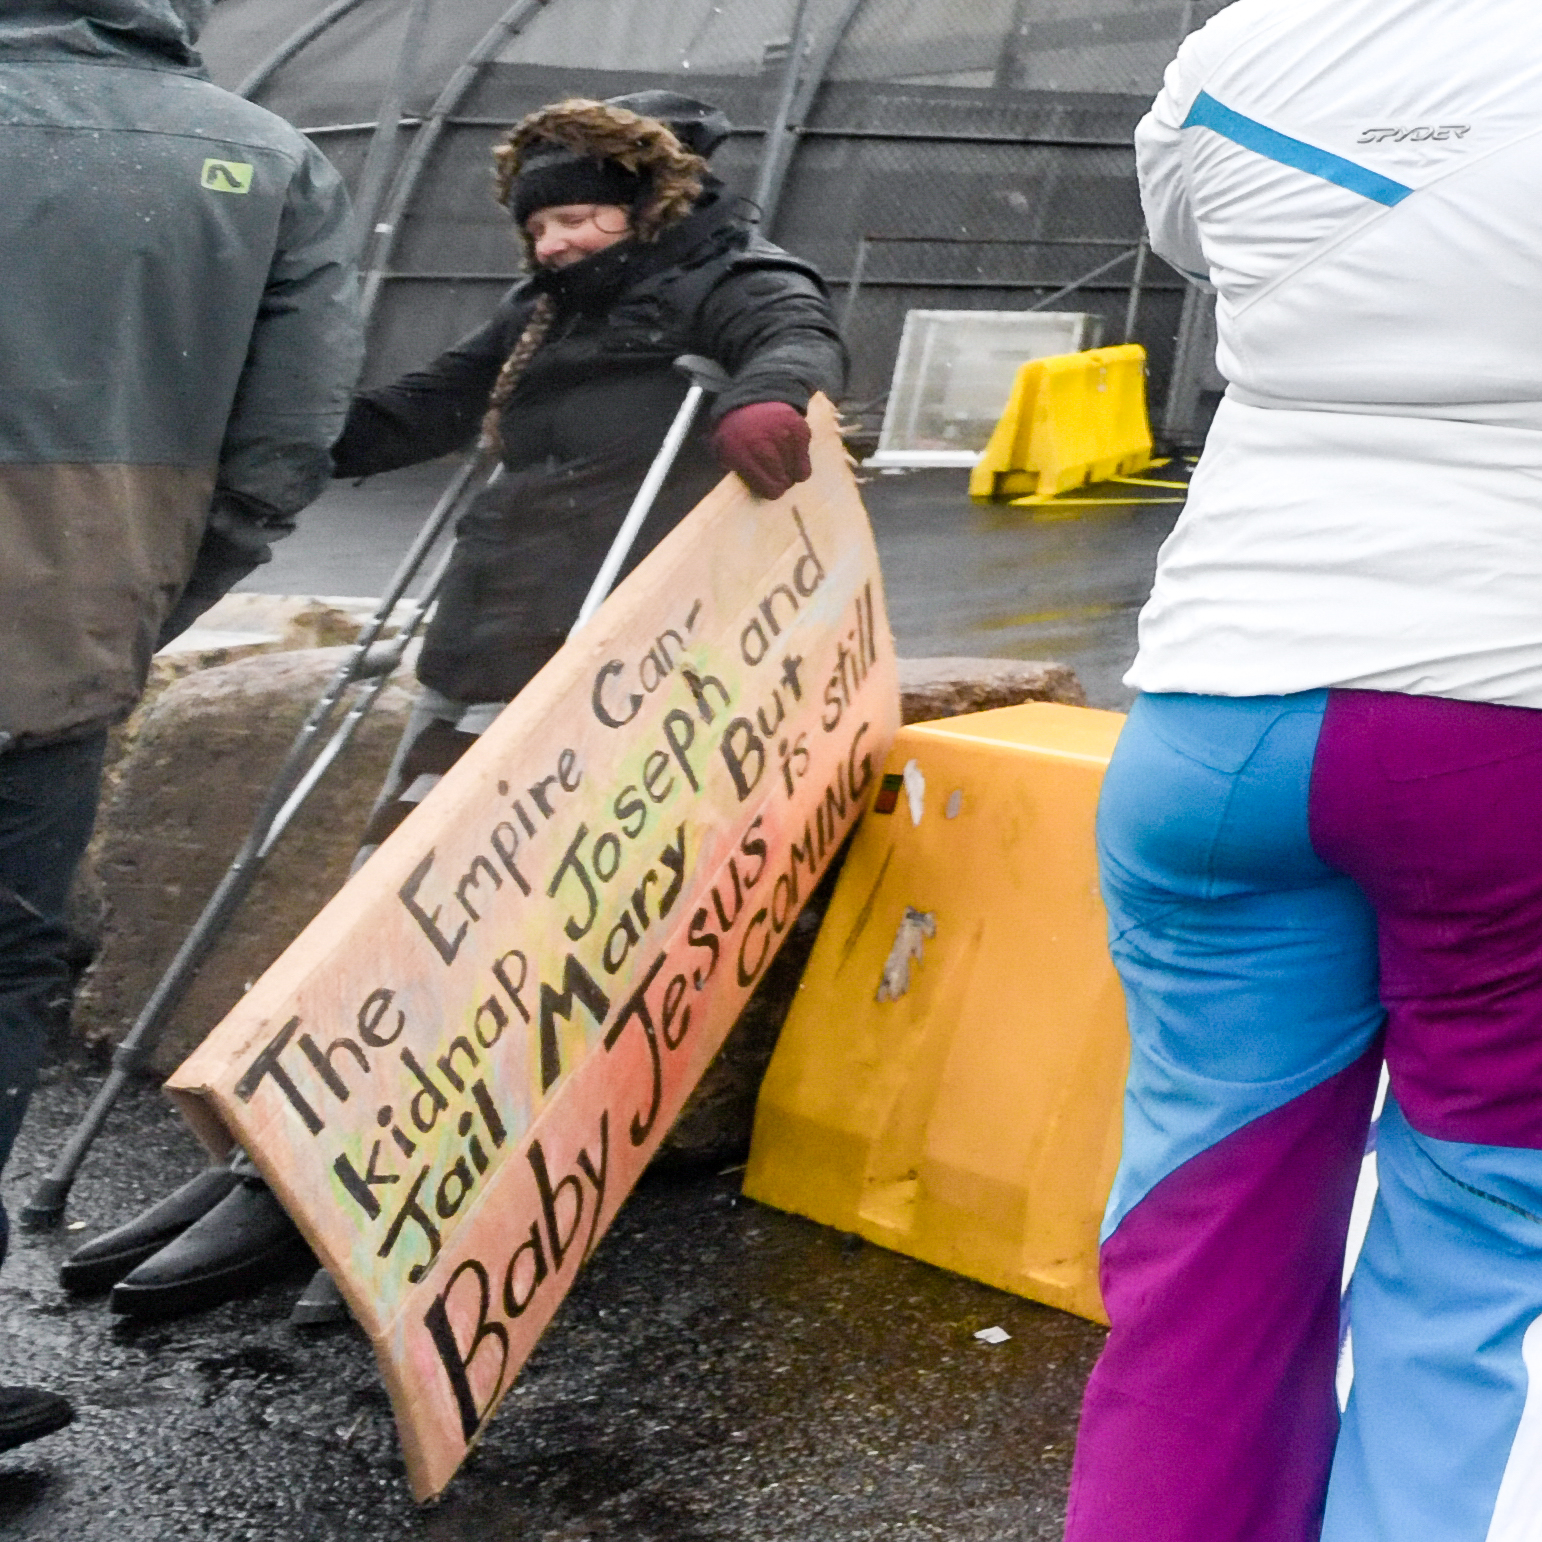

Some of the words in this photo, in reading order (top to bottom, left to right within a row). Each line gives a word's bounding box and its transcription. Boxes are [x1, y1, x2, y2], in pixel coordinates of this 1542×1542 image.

[1356, 124, 1472, 144] SPYDER
[234, 987, 405, 1137] The
[398, 747, 583, 967] Empire
[592, 598, 702, 729] Can-
[546, 667, 731, 941] Joseph
[738, 505, 827, 667] and
[737, 721, 872, 987] COMING
[377, 1078, 507, 1284] Jail
[539, 820, 688, 1096] Mary
[719, 654, 802, 802] But
[424, 1109, 609, 1444] Baby
[604, 815, 768, 1146] Jesus
[777, 732, 810, 800] is
[822, 580, 877, 733] still
